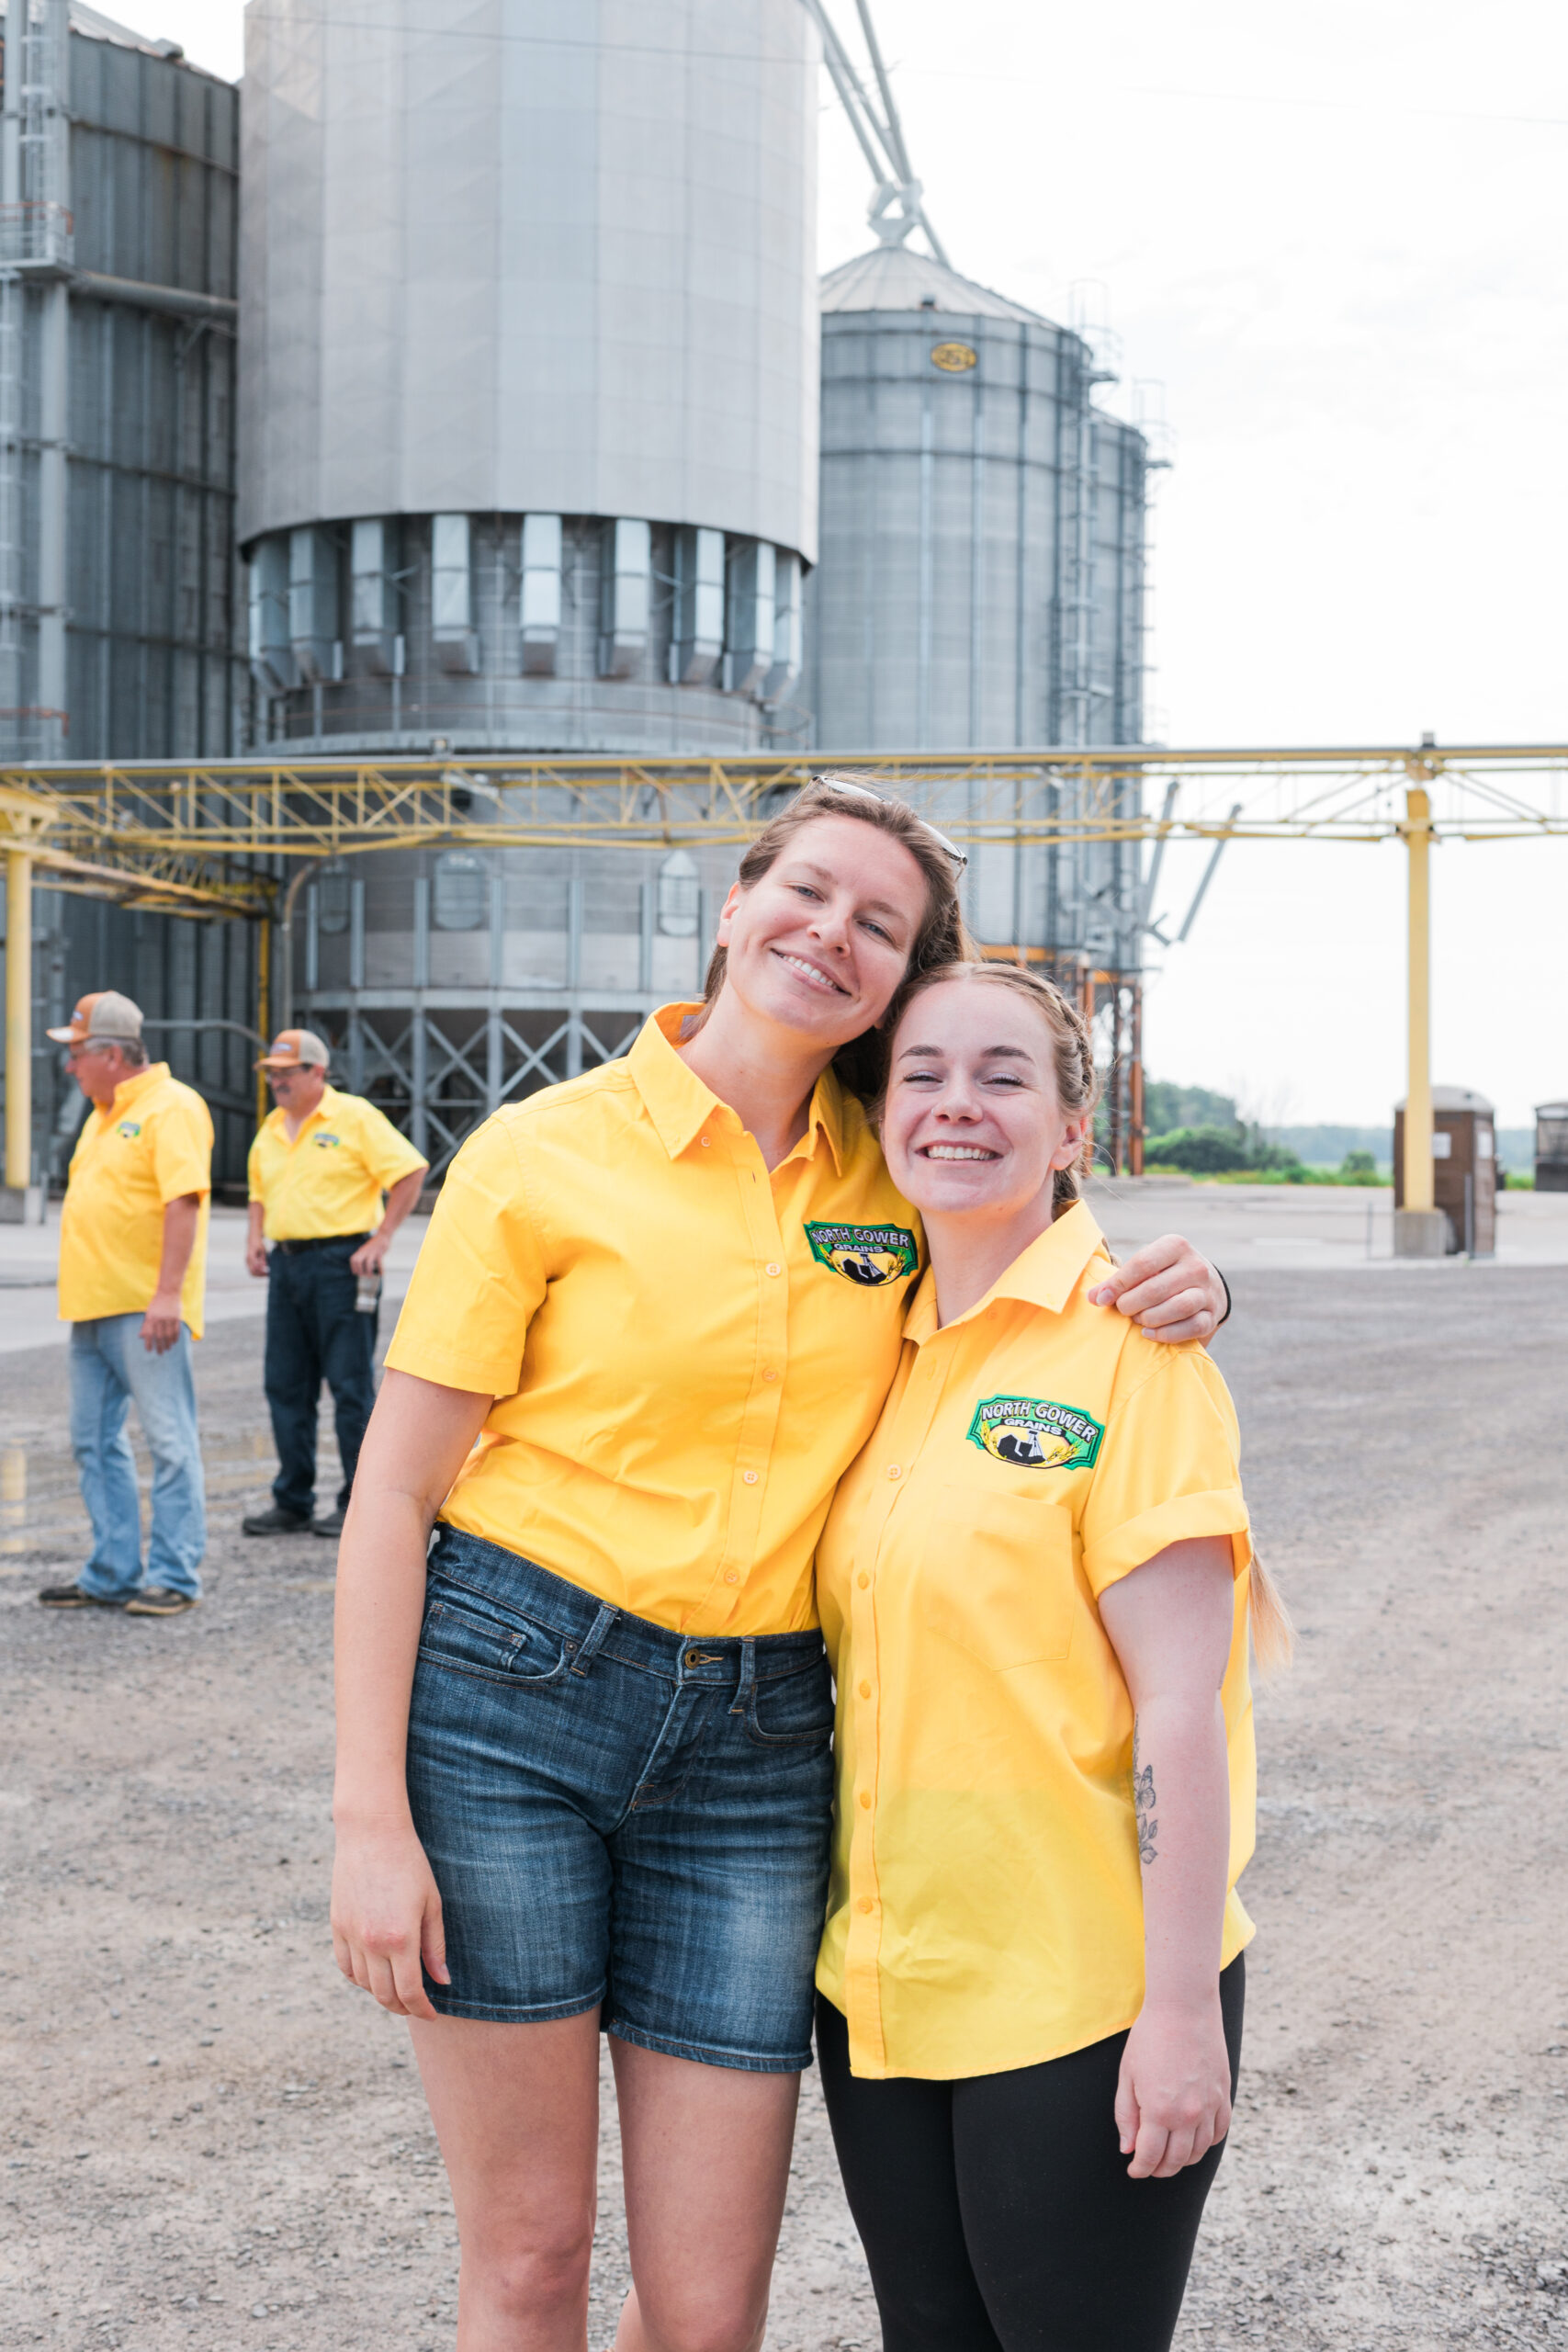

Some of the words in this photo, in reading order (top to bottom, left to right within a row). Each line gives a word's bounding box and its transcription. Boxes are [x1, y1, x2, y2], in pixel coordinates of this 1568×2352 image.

[811, 1227, 851, 1244] NORTH
[852, 1227, 909, 1248] GOWER
[833, 1243, 885, 1253] GRAINS
[981, 1401, 1032, 1421] NORTH
[1034, 1402, 1097, 1442] GOWER
[1003, 1418, 1064, 1436] GRAINS
